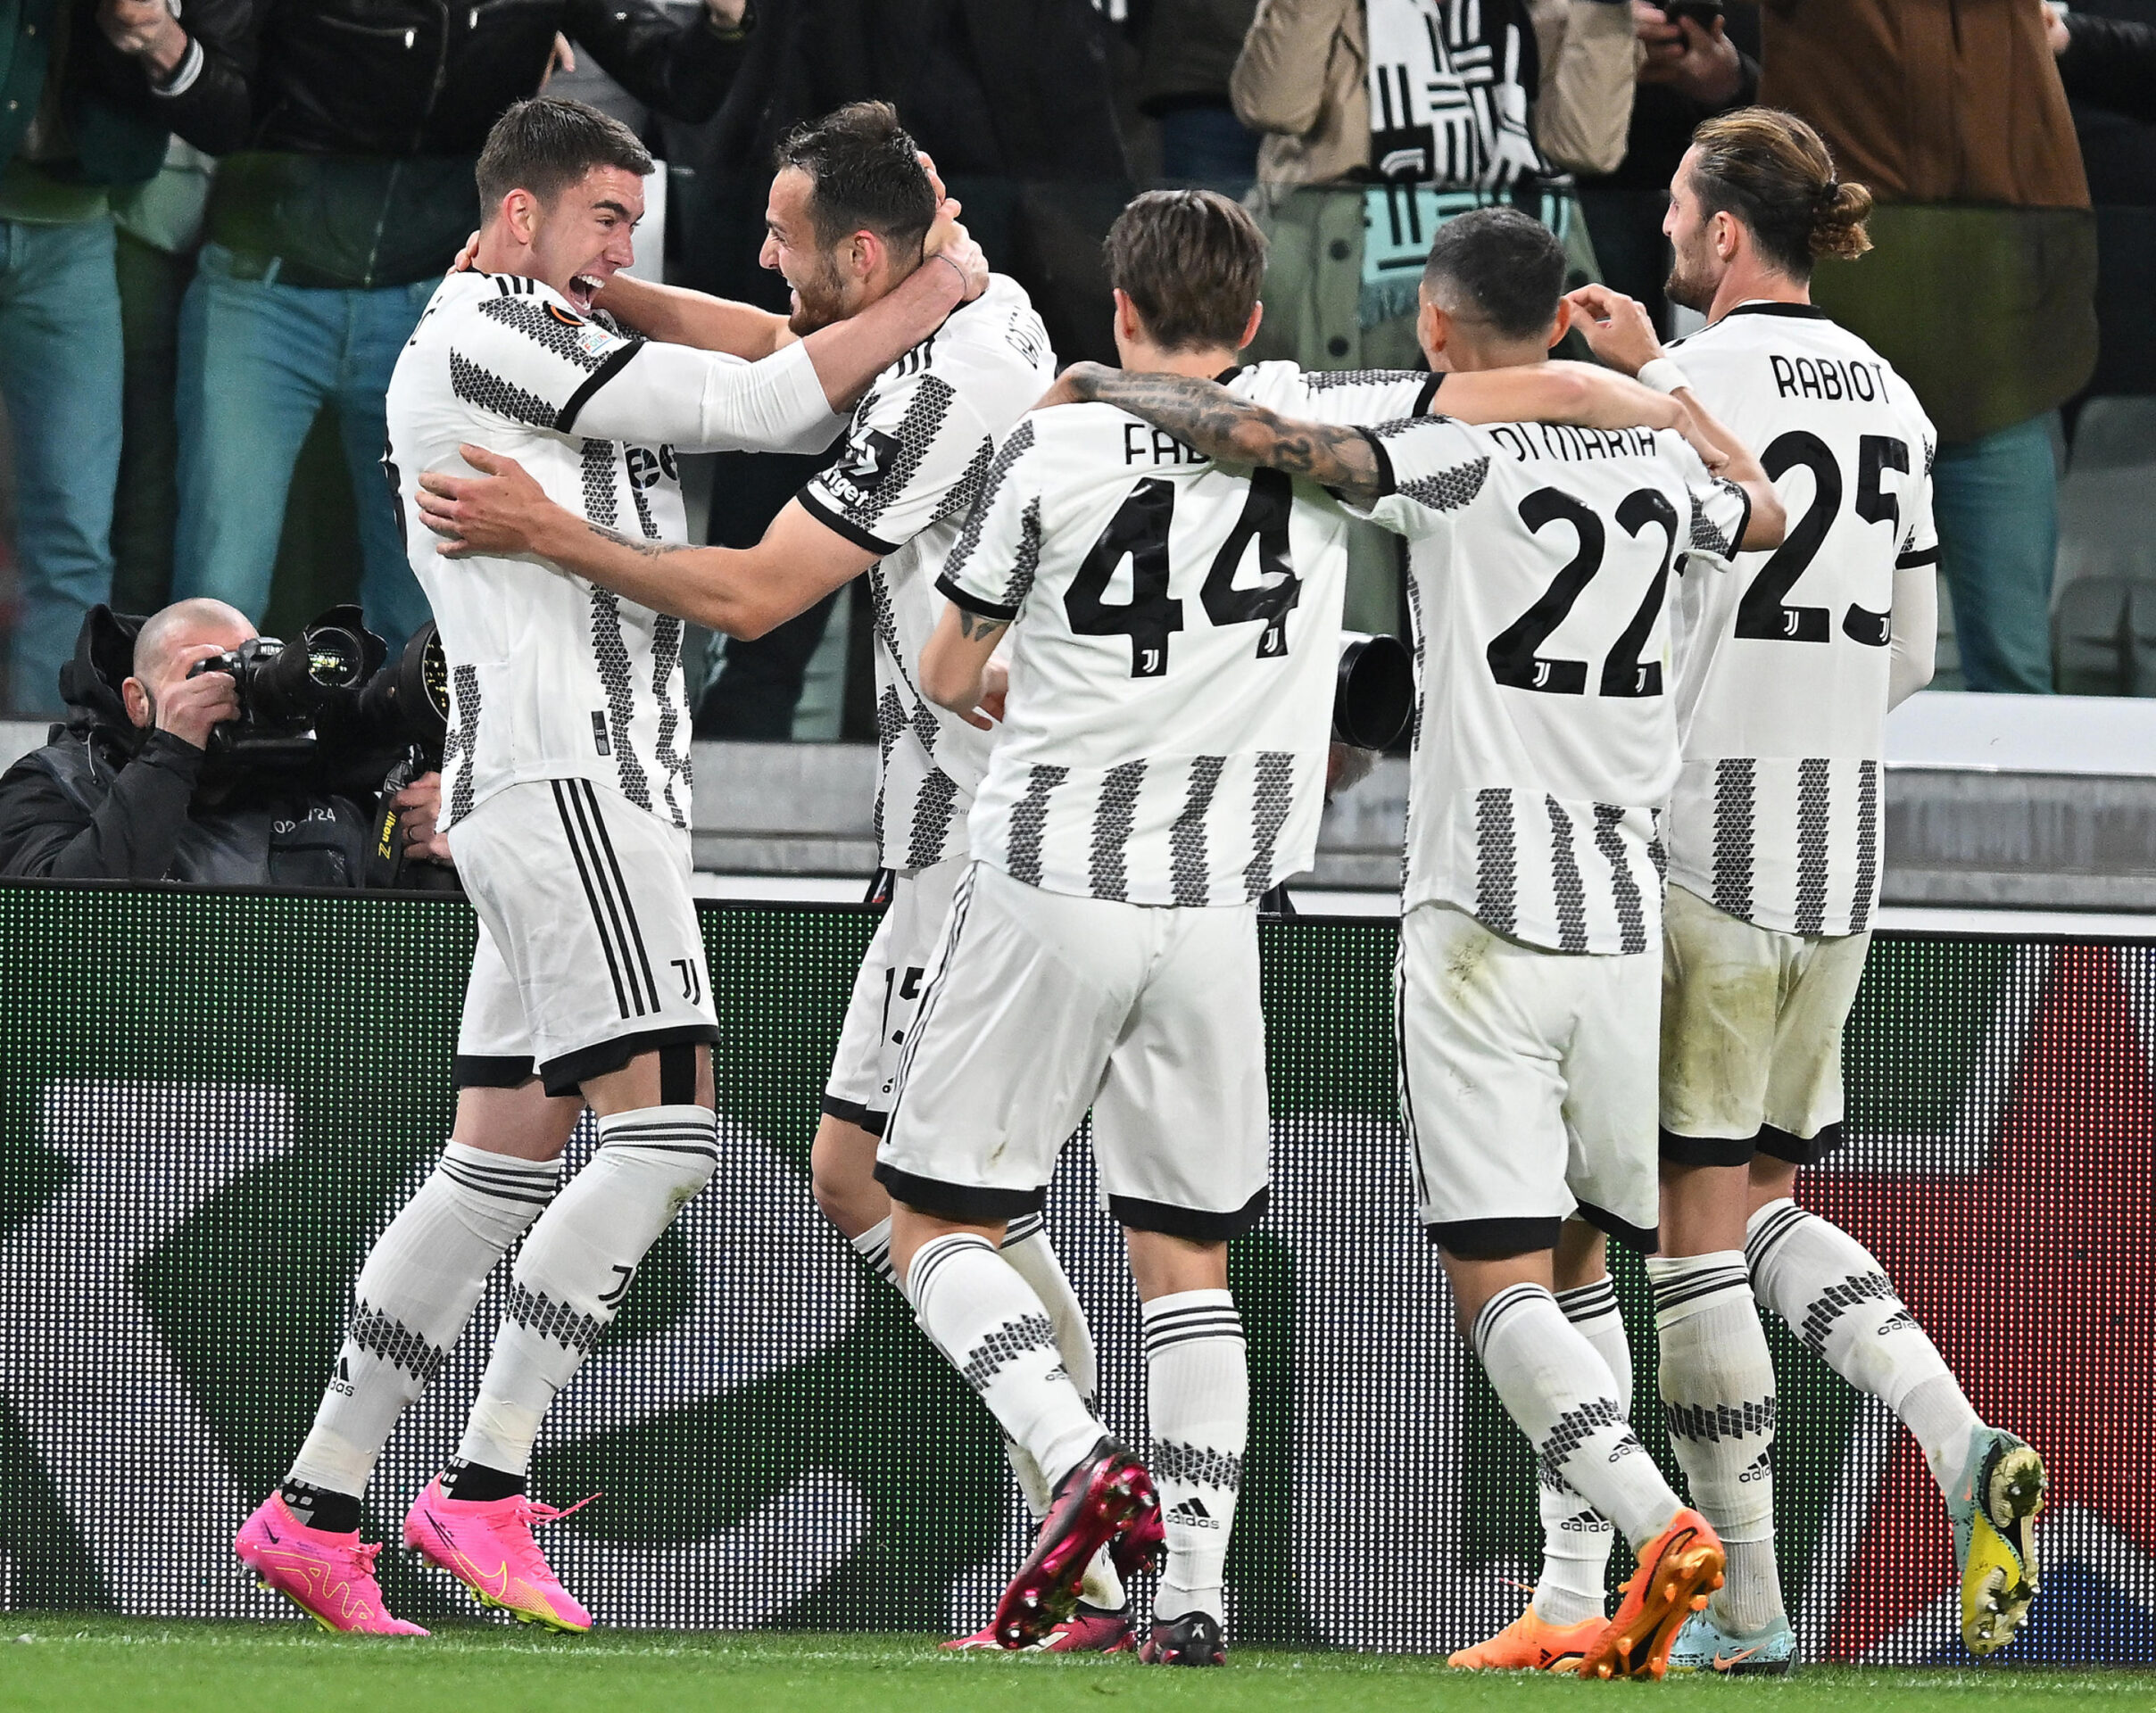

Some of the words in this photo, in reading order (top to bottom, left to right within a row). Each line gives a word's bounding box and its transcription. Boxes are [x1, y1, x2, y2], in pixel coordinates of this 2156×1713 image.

[1769, 354, 1890, 404] RABIOT
[1063, 466, 1305, 678] 44
[1486, 485, 1663, 698] 22
[1733, 430, 1911, 647] 25
